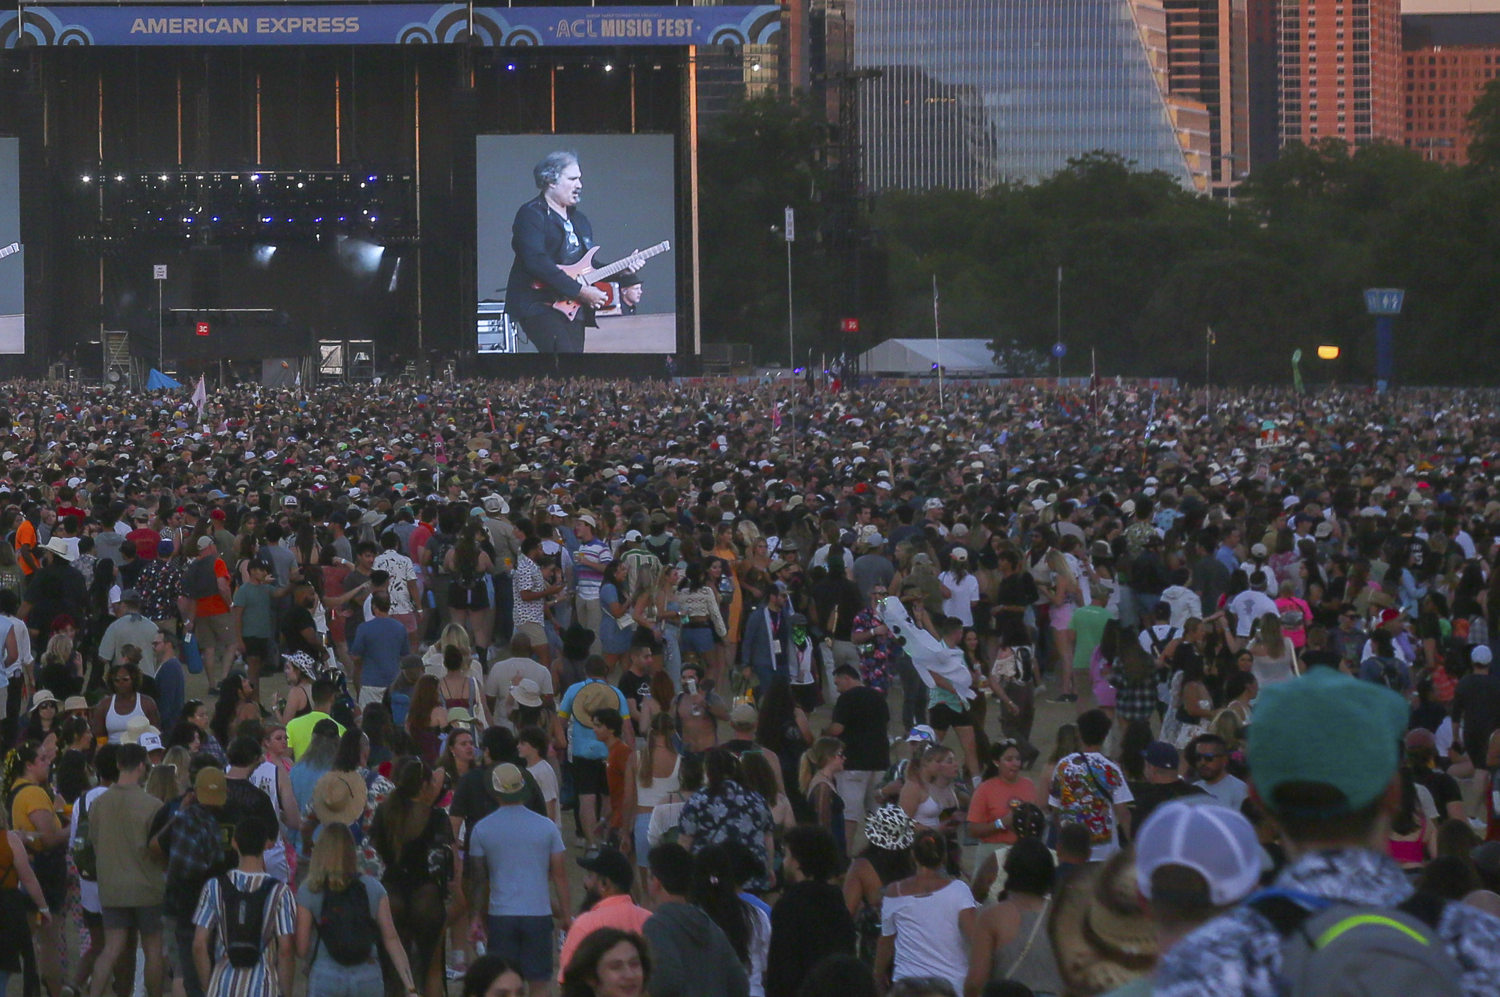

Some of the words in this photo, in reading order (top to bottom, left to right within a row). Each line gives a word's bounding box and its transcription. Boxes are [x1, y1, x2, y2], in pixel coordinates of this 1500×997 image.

[130, 18, 248, 34] AMERICAN
[256, 16, 360, 33] EXPRESS
[556, 19, 597, 38] ACL
[601, 19, 653, 37] MUSIC
[657, 18, 694, 37] FEST
